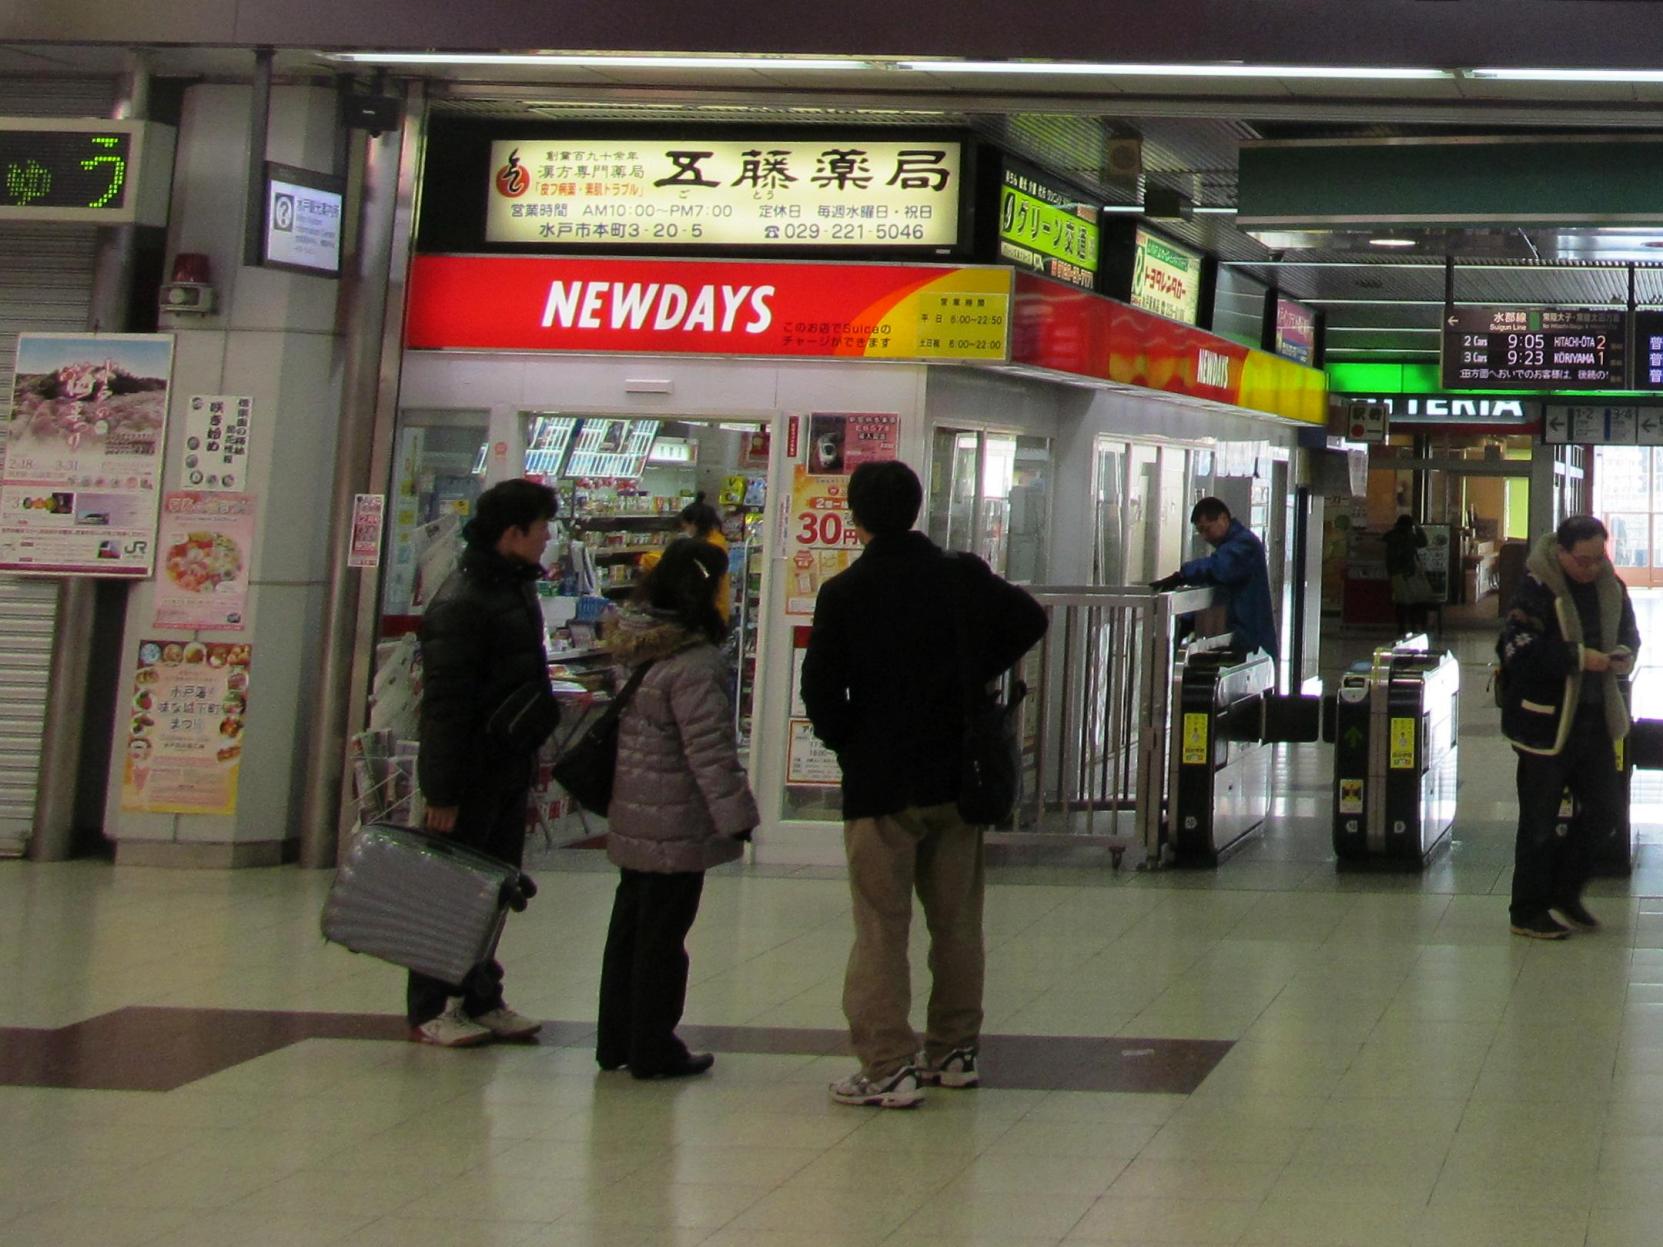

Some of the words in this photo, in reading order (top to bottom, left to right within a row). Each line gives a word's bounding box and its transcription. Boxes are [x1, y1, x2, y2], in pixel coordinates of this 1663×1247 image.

[538, 165, 644, 178] 漢方専門薬局
[679, 190, 689, 199] ご
[753, 190, 774, 200] とう
[511, 204, 567, 217] 営業時間
[759, 205, 800, 218] 定休日
[817, 205, 932, 218] 毎週水曜日・祝日
[1145, 265, 1186, 299] トヨタレンタカー
[541, 280, 775, 333] NEWDAYS
[1494, 312, 1526, 323] 水郡線
[782, 322, 891, 335] このお店でSuicaの
[782, 335, 890, 348] チャージができます
[1464, 336, 1470, 346] 2
[1508, 334, 1544, 349] 9:05
[1597, 336, 1606, 349] 2
[1464, 352, 1470, 362] 3
[1508, 352, 1544, 365] 9:23
[1599, 352, 1604, 365] 1
[125, 541, 147, 554] JR
